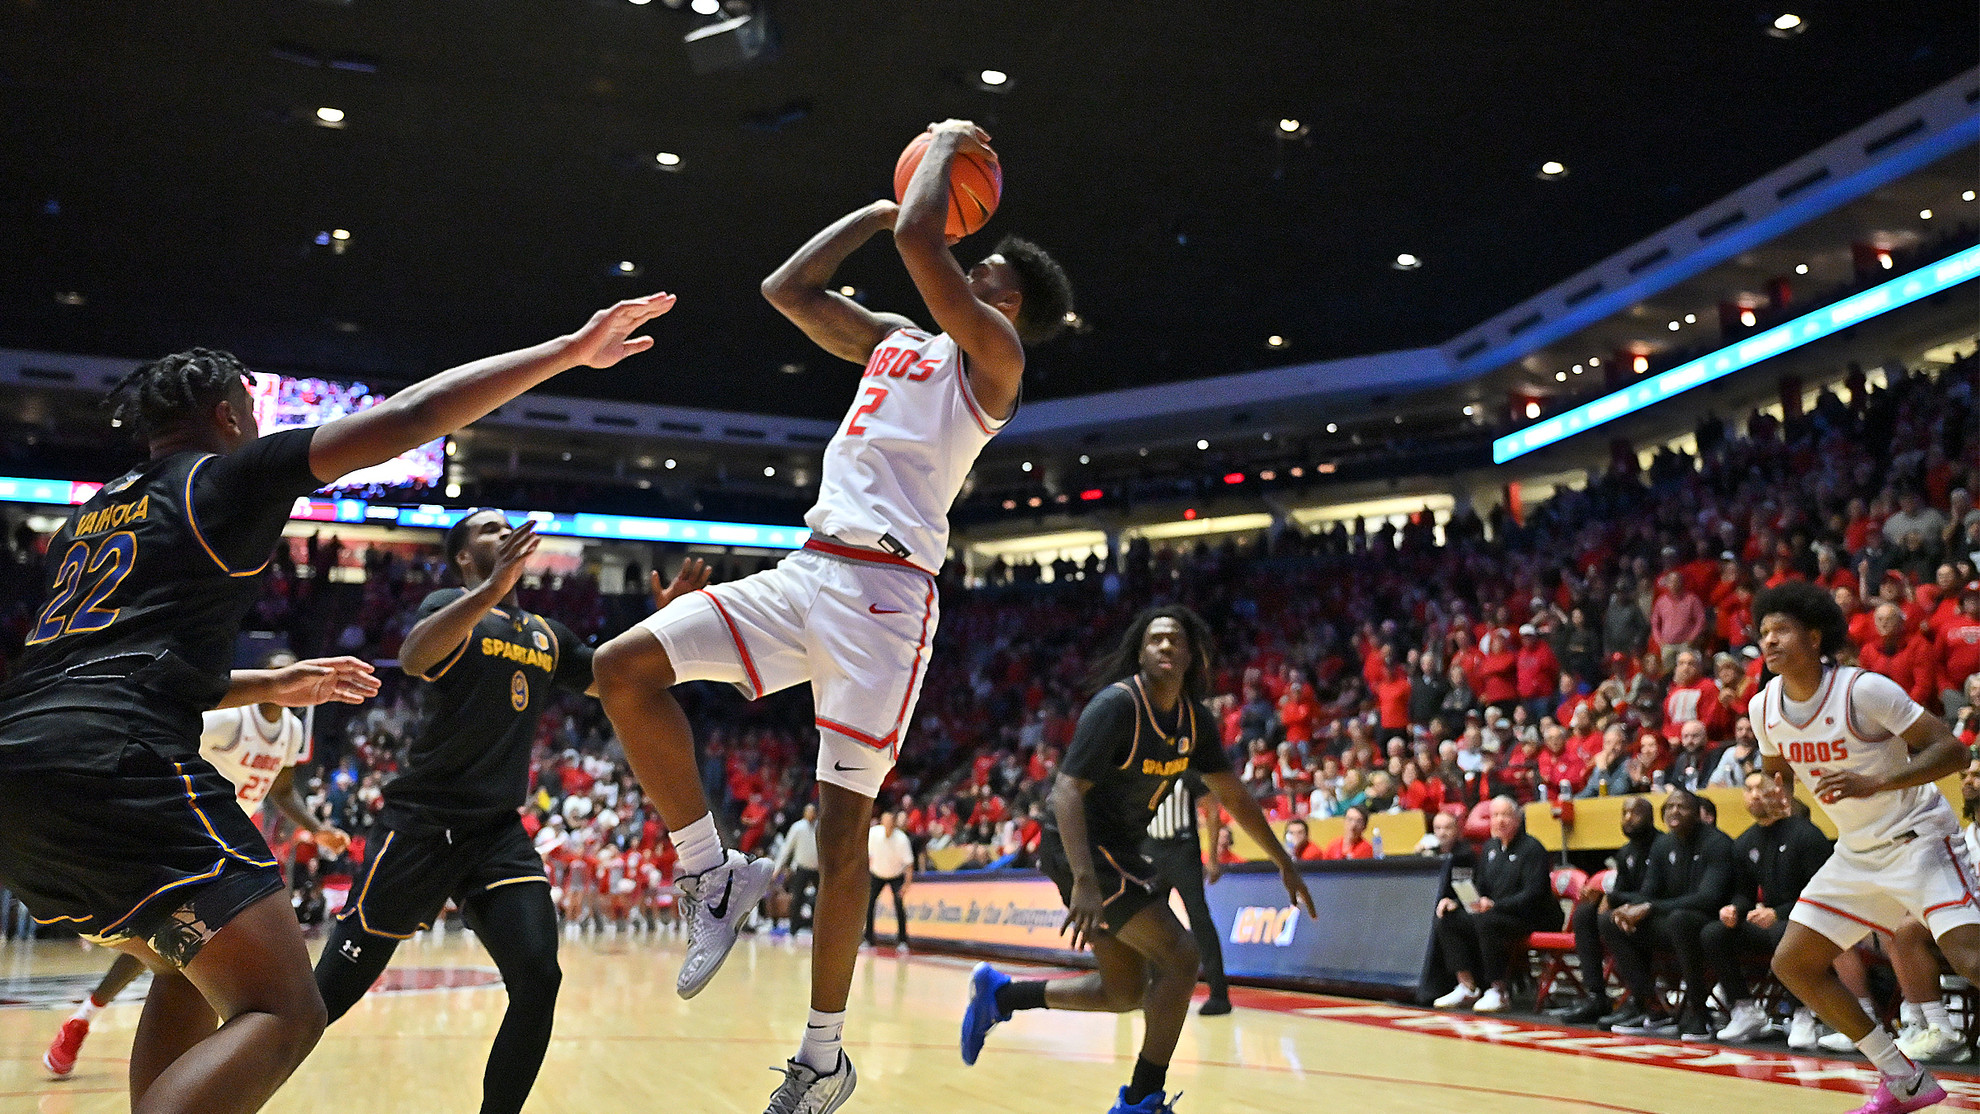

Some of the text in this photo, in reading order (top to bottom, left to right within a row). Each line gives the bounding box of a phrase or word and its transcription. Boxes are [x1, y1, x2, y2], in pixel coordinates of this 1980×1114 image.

[862, 346, 944, 382] OBOS
[846, 387, 889, 436] 2
[25, 530, 138, 647] 22
[481, 637, 554, 673] SPARTANS
[1777, 737, 1849, 763] LOBOS
